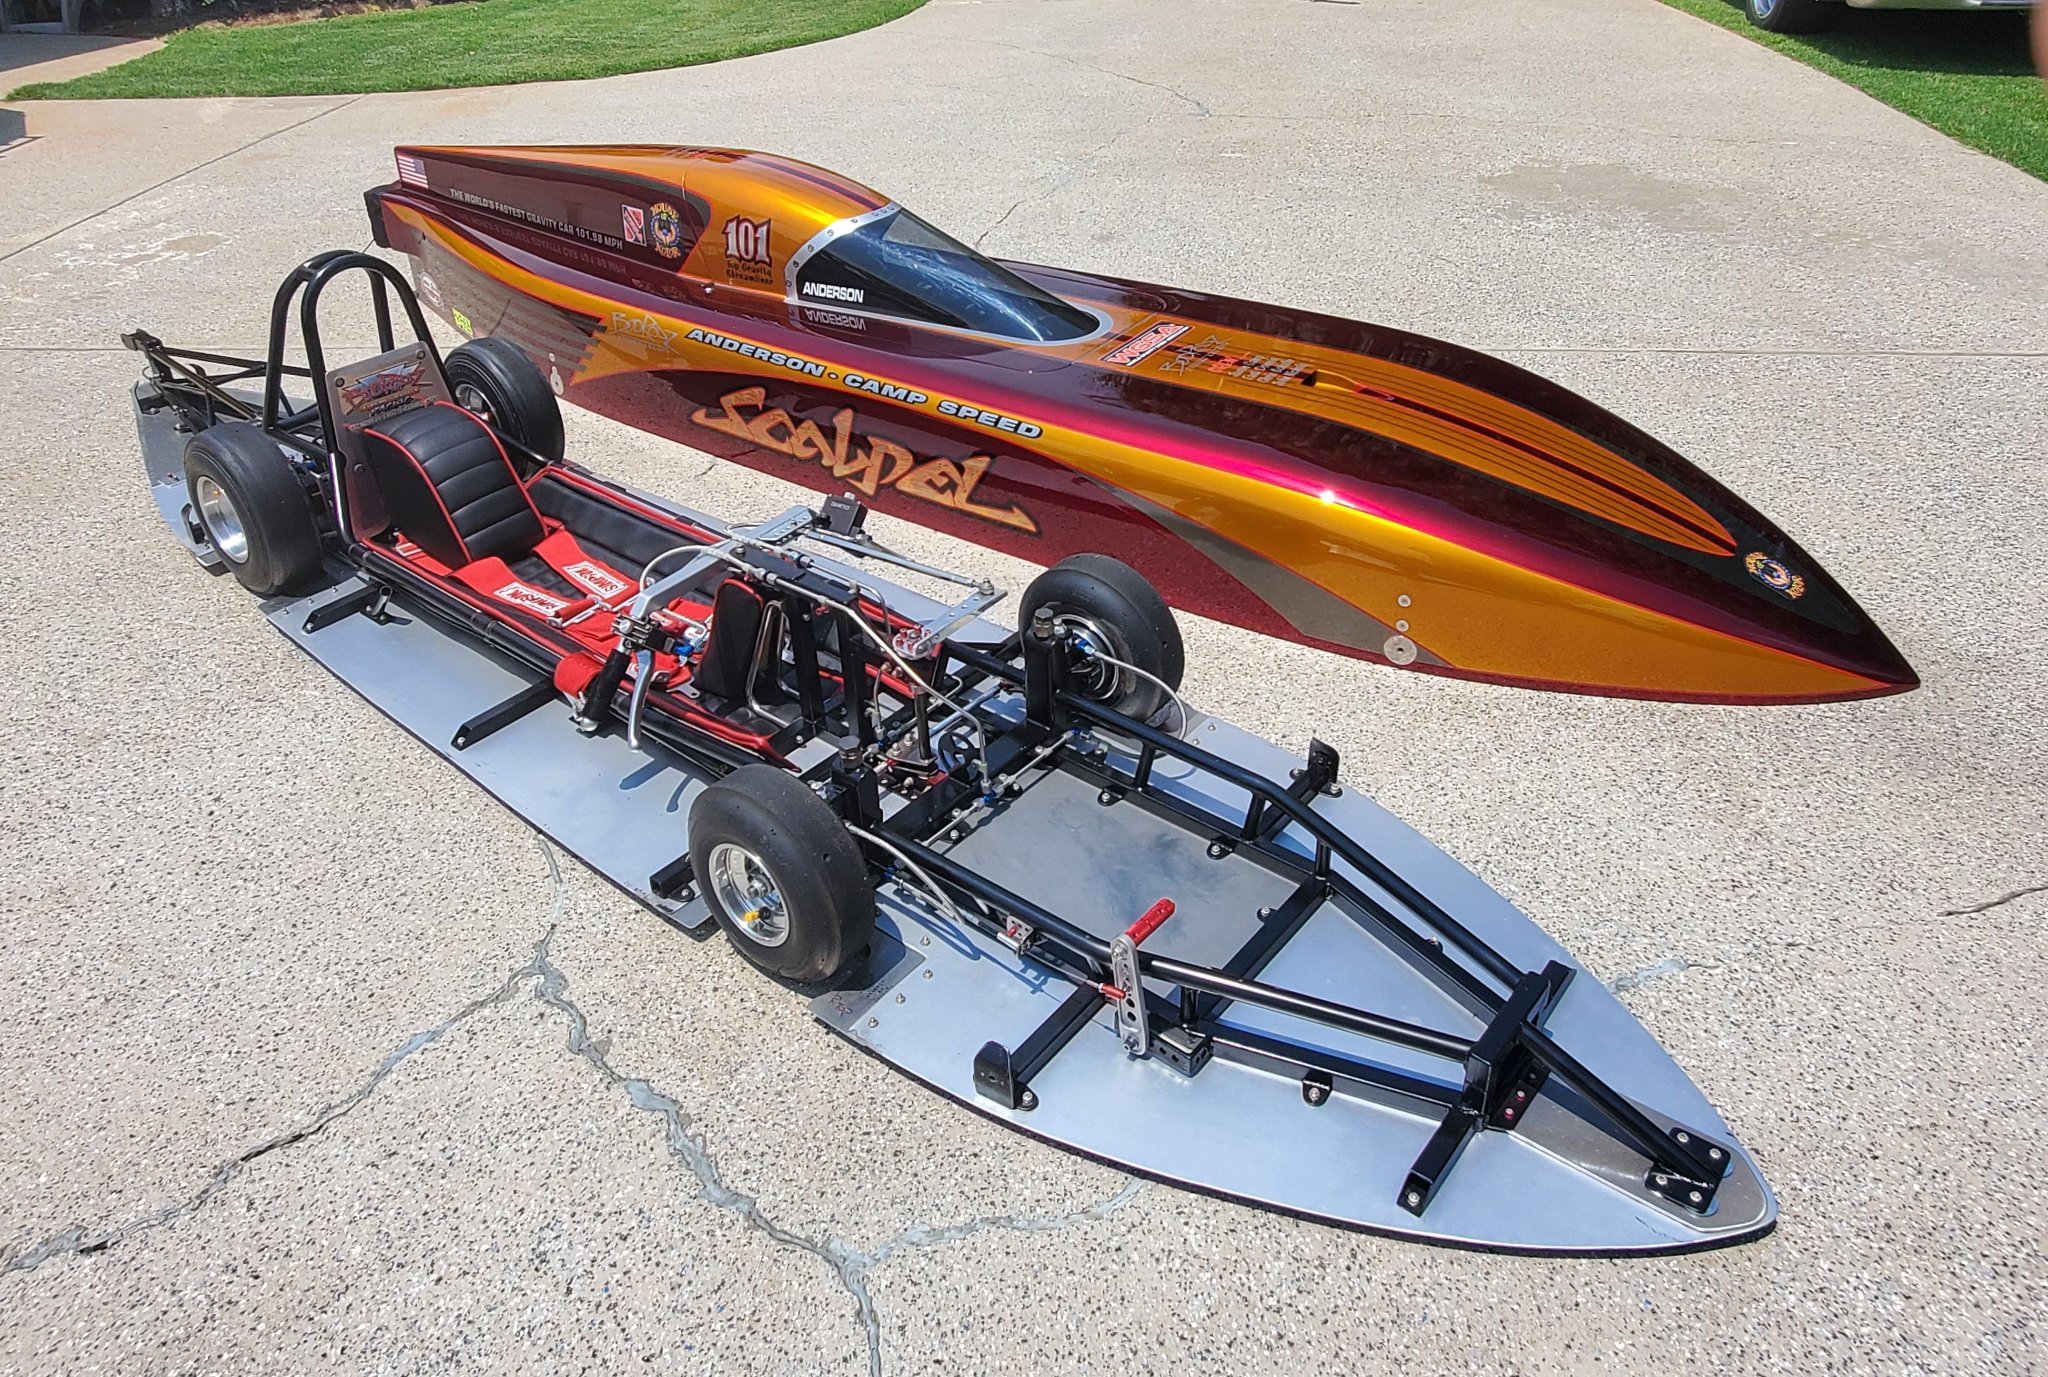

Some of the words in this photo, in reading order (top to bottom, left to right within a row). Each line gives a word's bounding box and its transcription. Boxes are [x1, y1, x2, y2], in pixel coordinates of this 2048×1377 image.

[450, 188, 463, 200] THE
[463, 192, 494, 210] WORLD'S
[495, 202, 526, 220] FASTEST
[526, 212, 558, 230] GRAVITY
[558, 222, 574, 235] CAR
[575, 227, 603, 243] 101.98
[604, 235, 623, 250] MPH
[722, 215, 772, 267] 101
[802, 281, 864, 303] ANDERSON
[1106, 325, 1185, 364] WGSA
[685, 328, 826, 378] ANDERSON
[842, 372, 928, 406] CAMP
[937, 399, 1044, 439] SPEED
